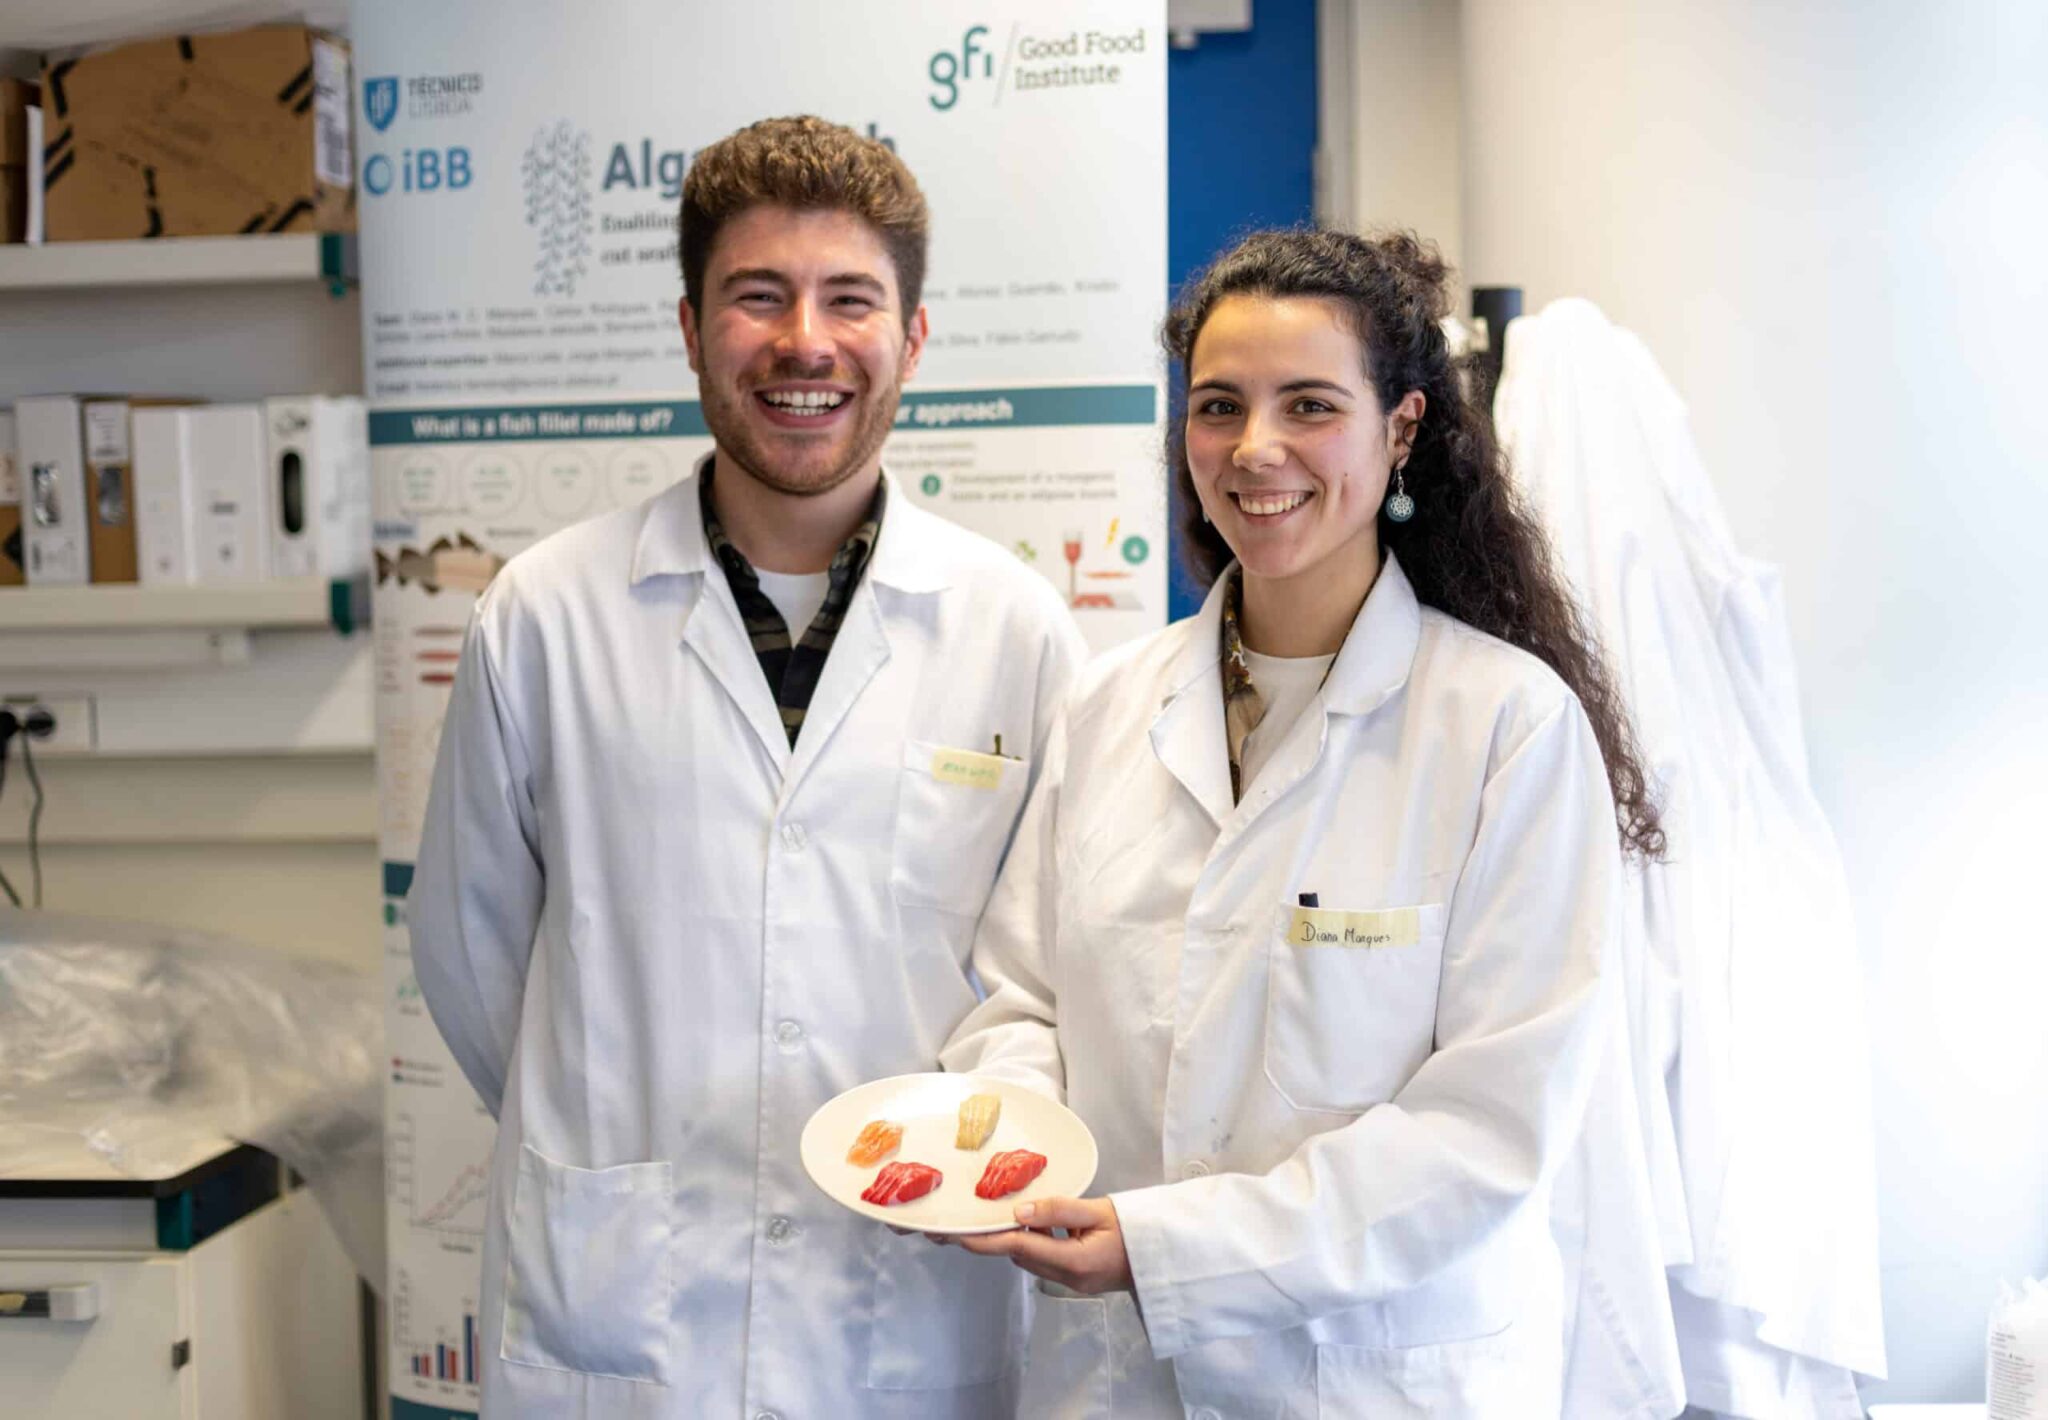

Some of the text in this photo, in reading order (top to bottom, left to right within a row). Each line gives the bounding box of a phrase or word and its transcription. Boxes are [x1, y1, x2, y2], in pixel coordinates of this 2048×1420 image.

[1019, 28, 1144, 59] Good Food
[928, 26, 991, 111] gfi
[1015, 64, 1121, 90] Institute
[402, 147, 472, 192] iBB
[602, 138, 686, 199] Alg
[412, 408, 674, 437] What is a fish fillet made of?
[915, 398, 1013, 427] approach
[1301, 921, 1390, 951] Diana Marques
